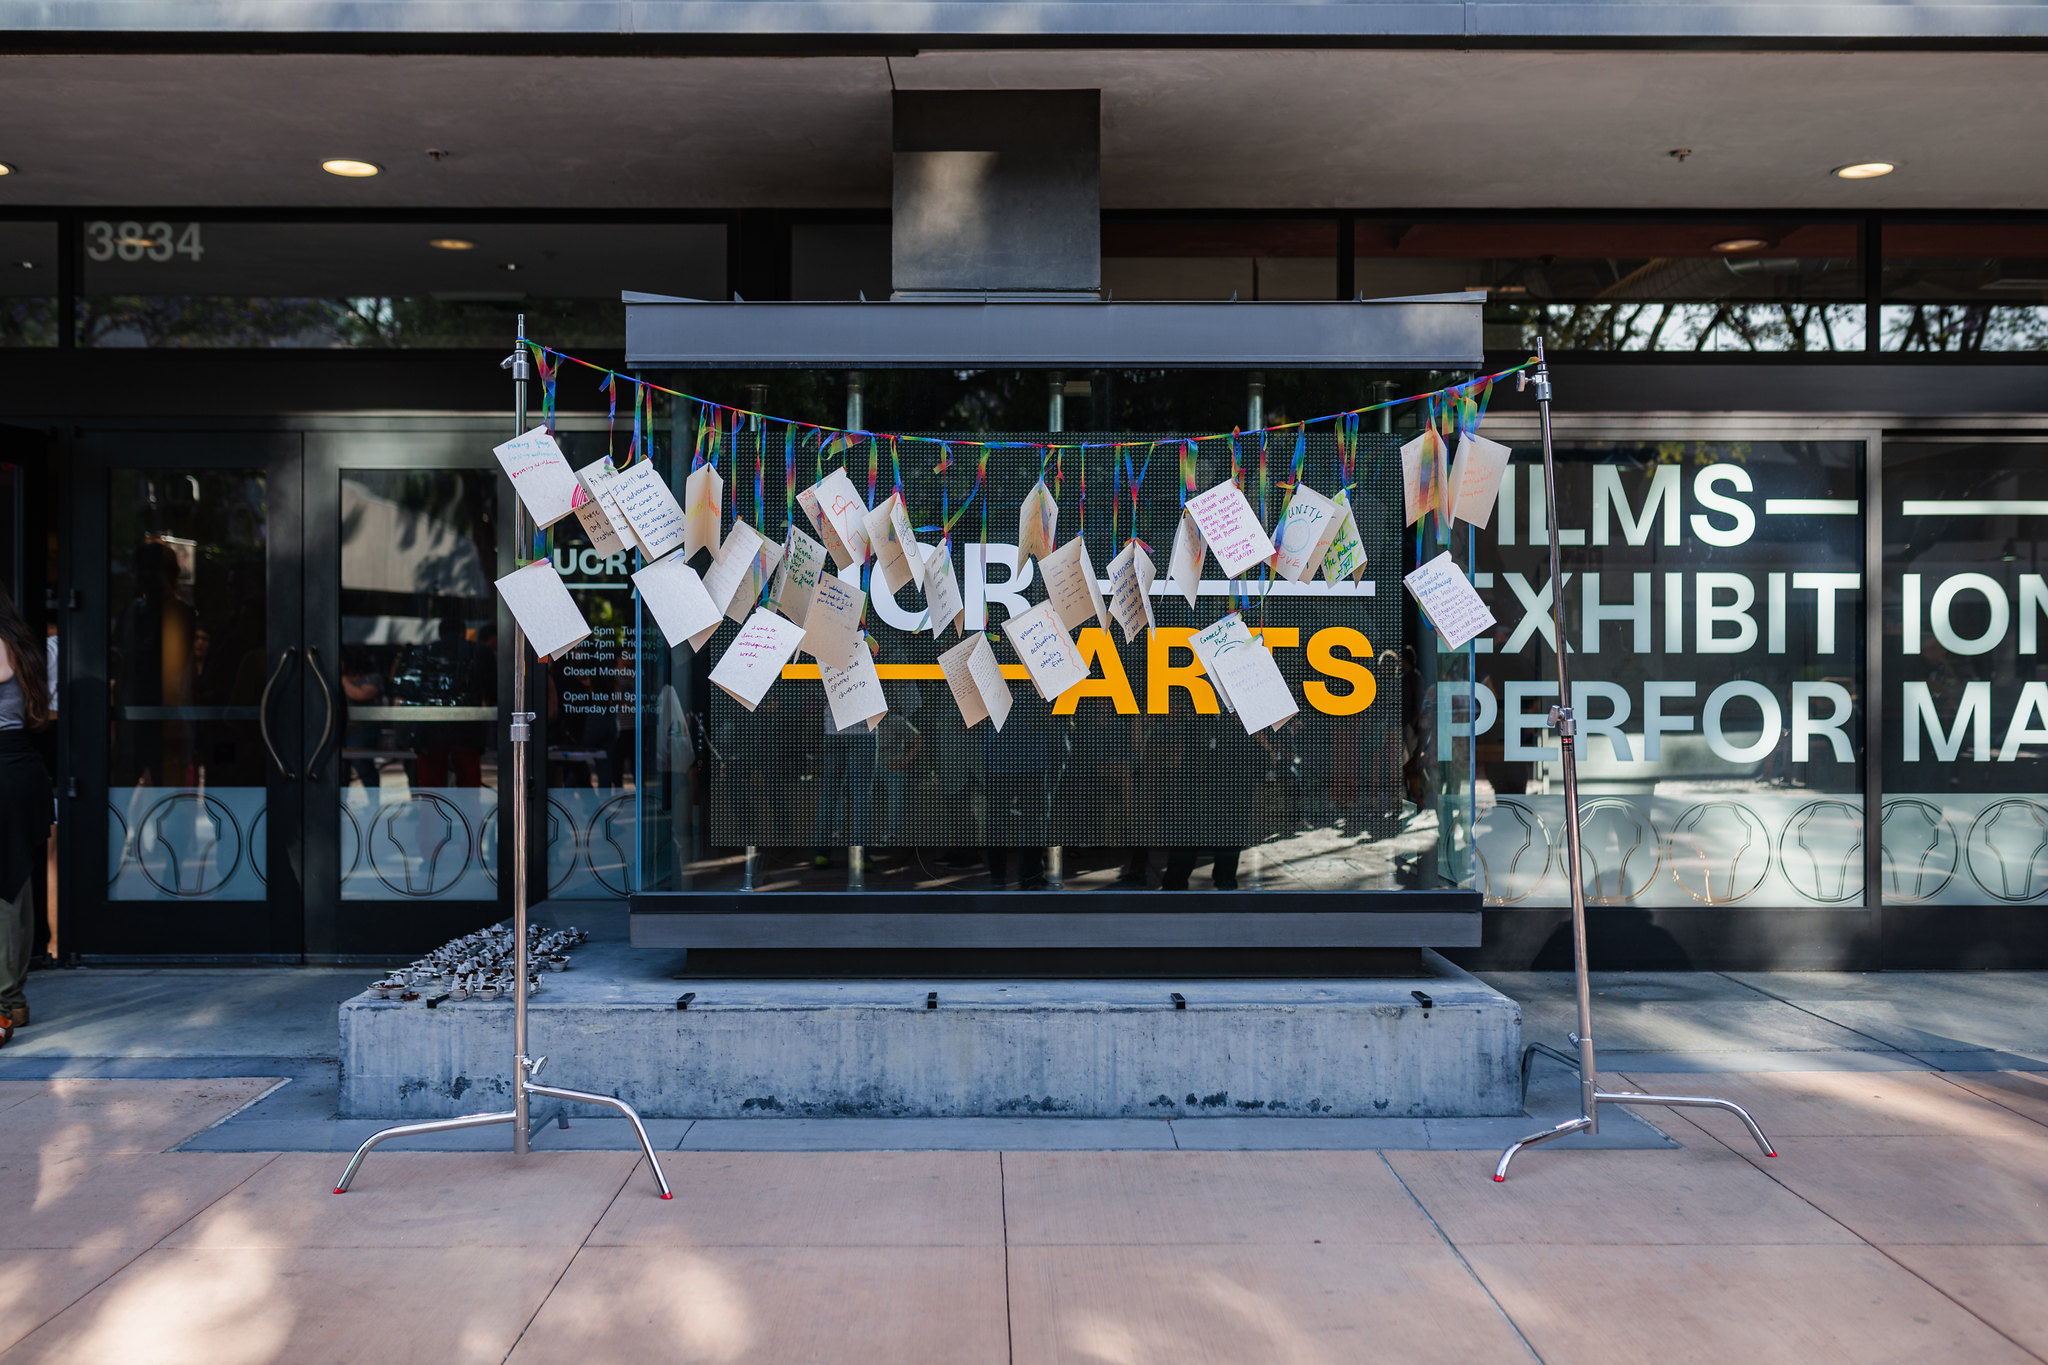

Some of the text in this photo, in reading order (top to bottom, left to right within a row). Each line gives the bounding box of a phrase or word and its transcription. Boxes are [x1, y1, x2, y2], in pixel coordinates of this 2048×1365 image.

[88, 221, 204, 262] 3834
[1288, 504, 1323, 523] UNITY
[1498, 464, 1756, 547] ILMS
[551, 548, 628, 576] UCR
[838, 543, 1040, 633] CR
[563, 667, 597, 677] Closed
[563, 691, 589, 703] Open
[592, 692, 609, 702] late
[611, 692, 622, 701] till
[563, 704, 607, 715] Thursday
[609, 704, 619, 713] of
[1437, 681, 1856, 763] PERFOR
